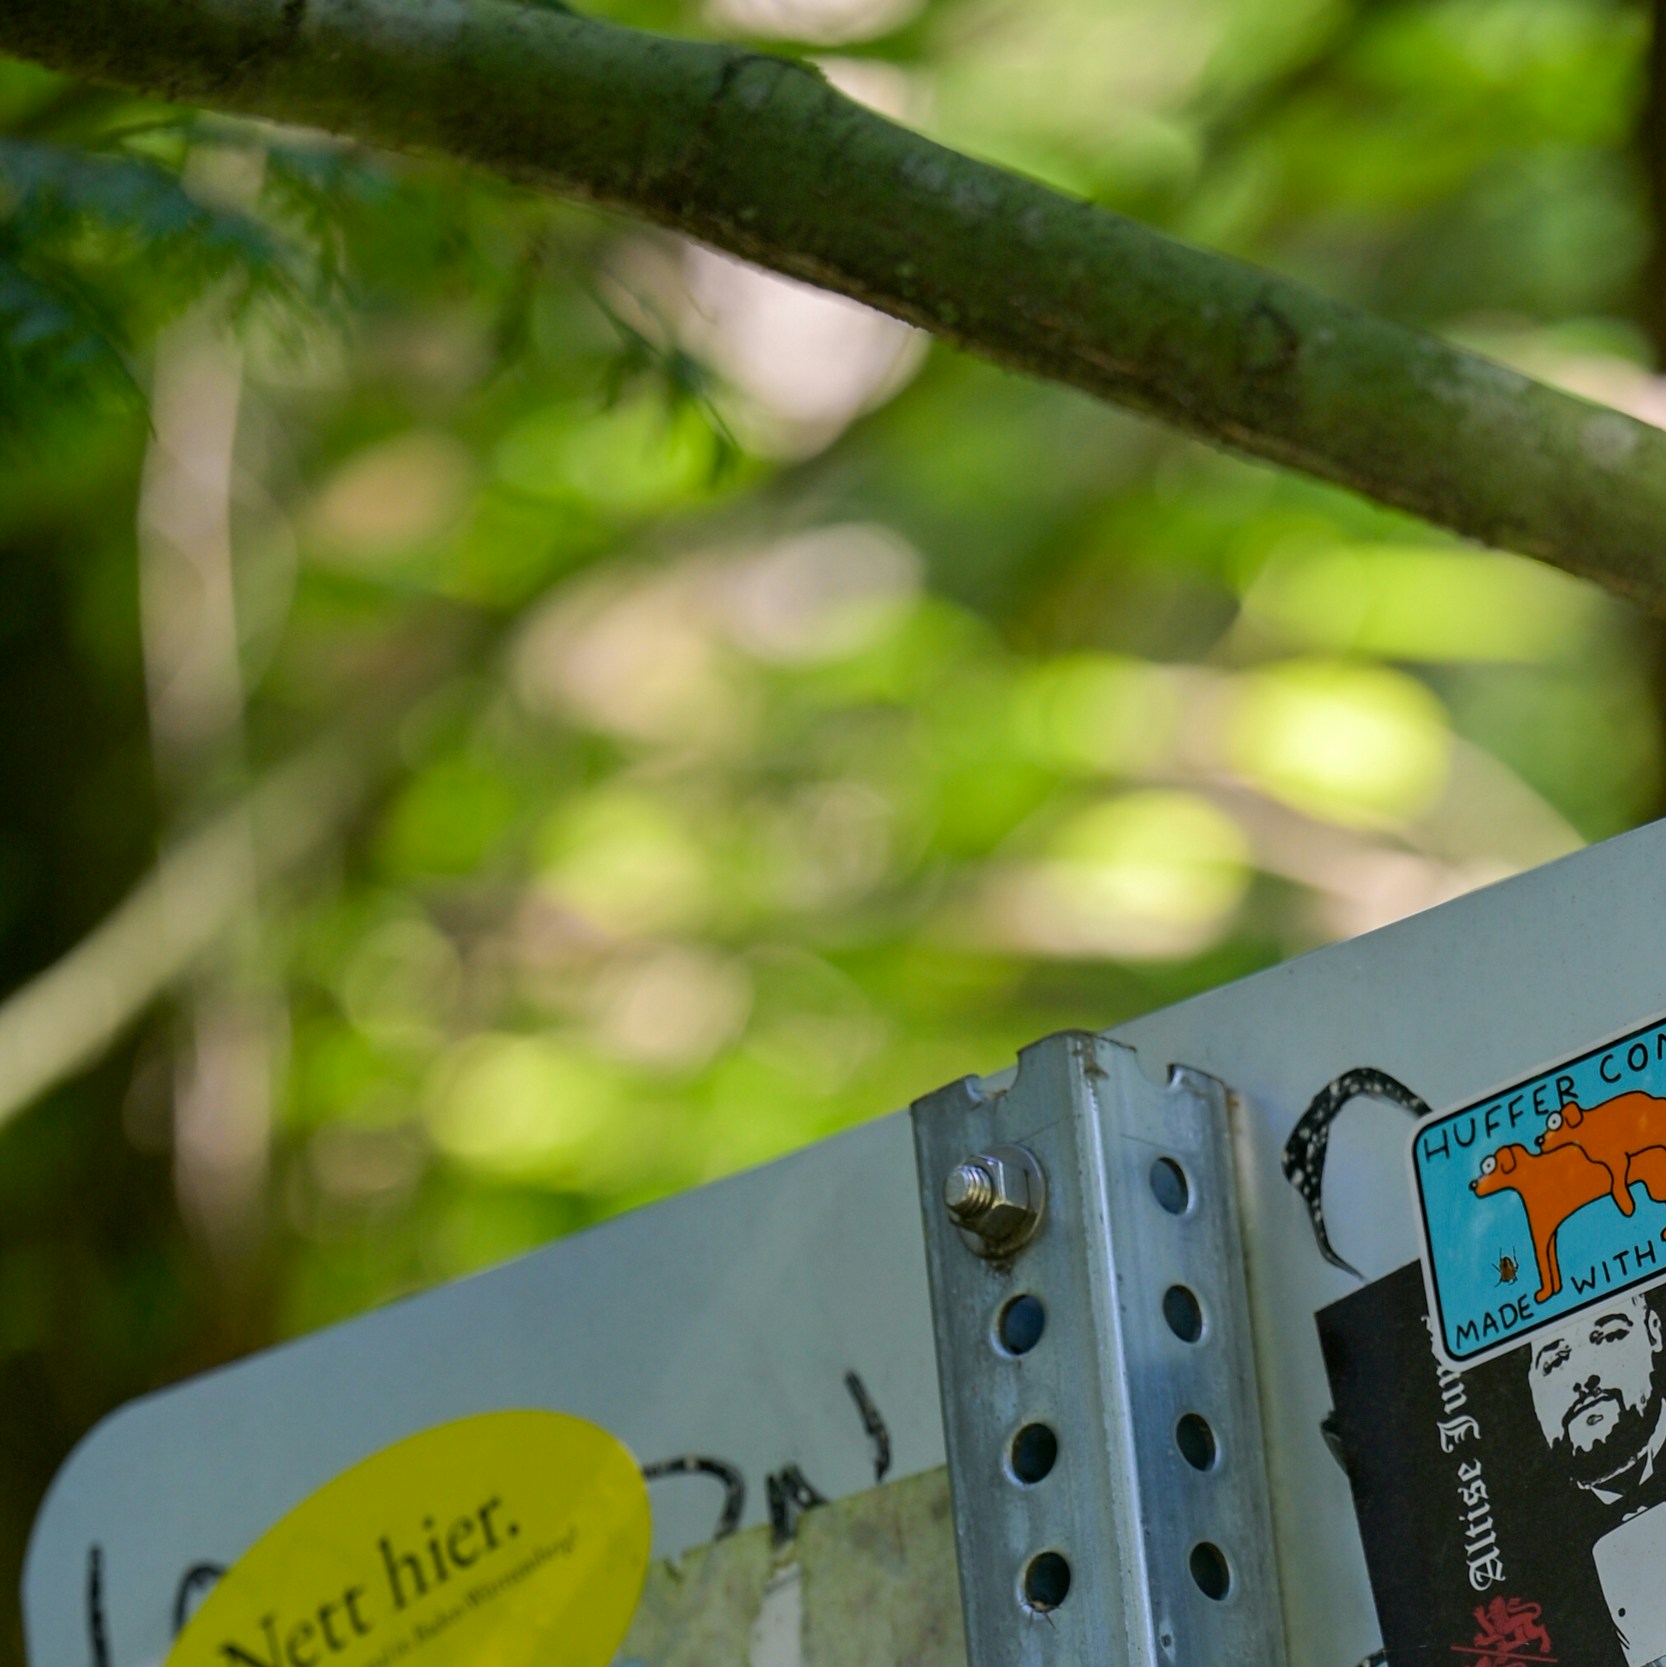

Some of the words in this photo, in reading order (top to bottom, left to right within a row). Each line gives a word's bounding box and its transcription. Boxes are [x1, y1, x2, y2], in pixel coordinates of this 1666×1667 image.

[1423, 1076, 1578, 1163] HUFFER
[1455, 1294, 1534, 1348] MADE
[1571, 1241, 1656, 1295] WITH
[377, 1494, 521, 1612] hier.
